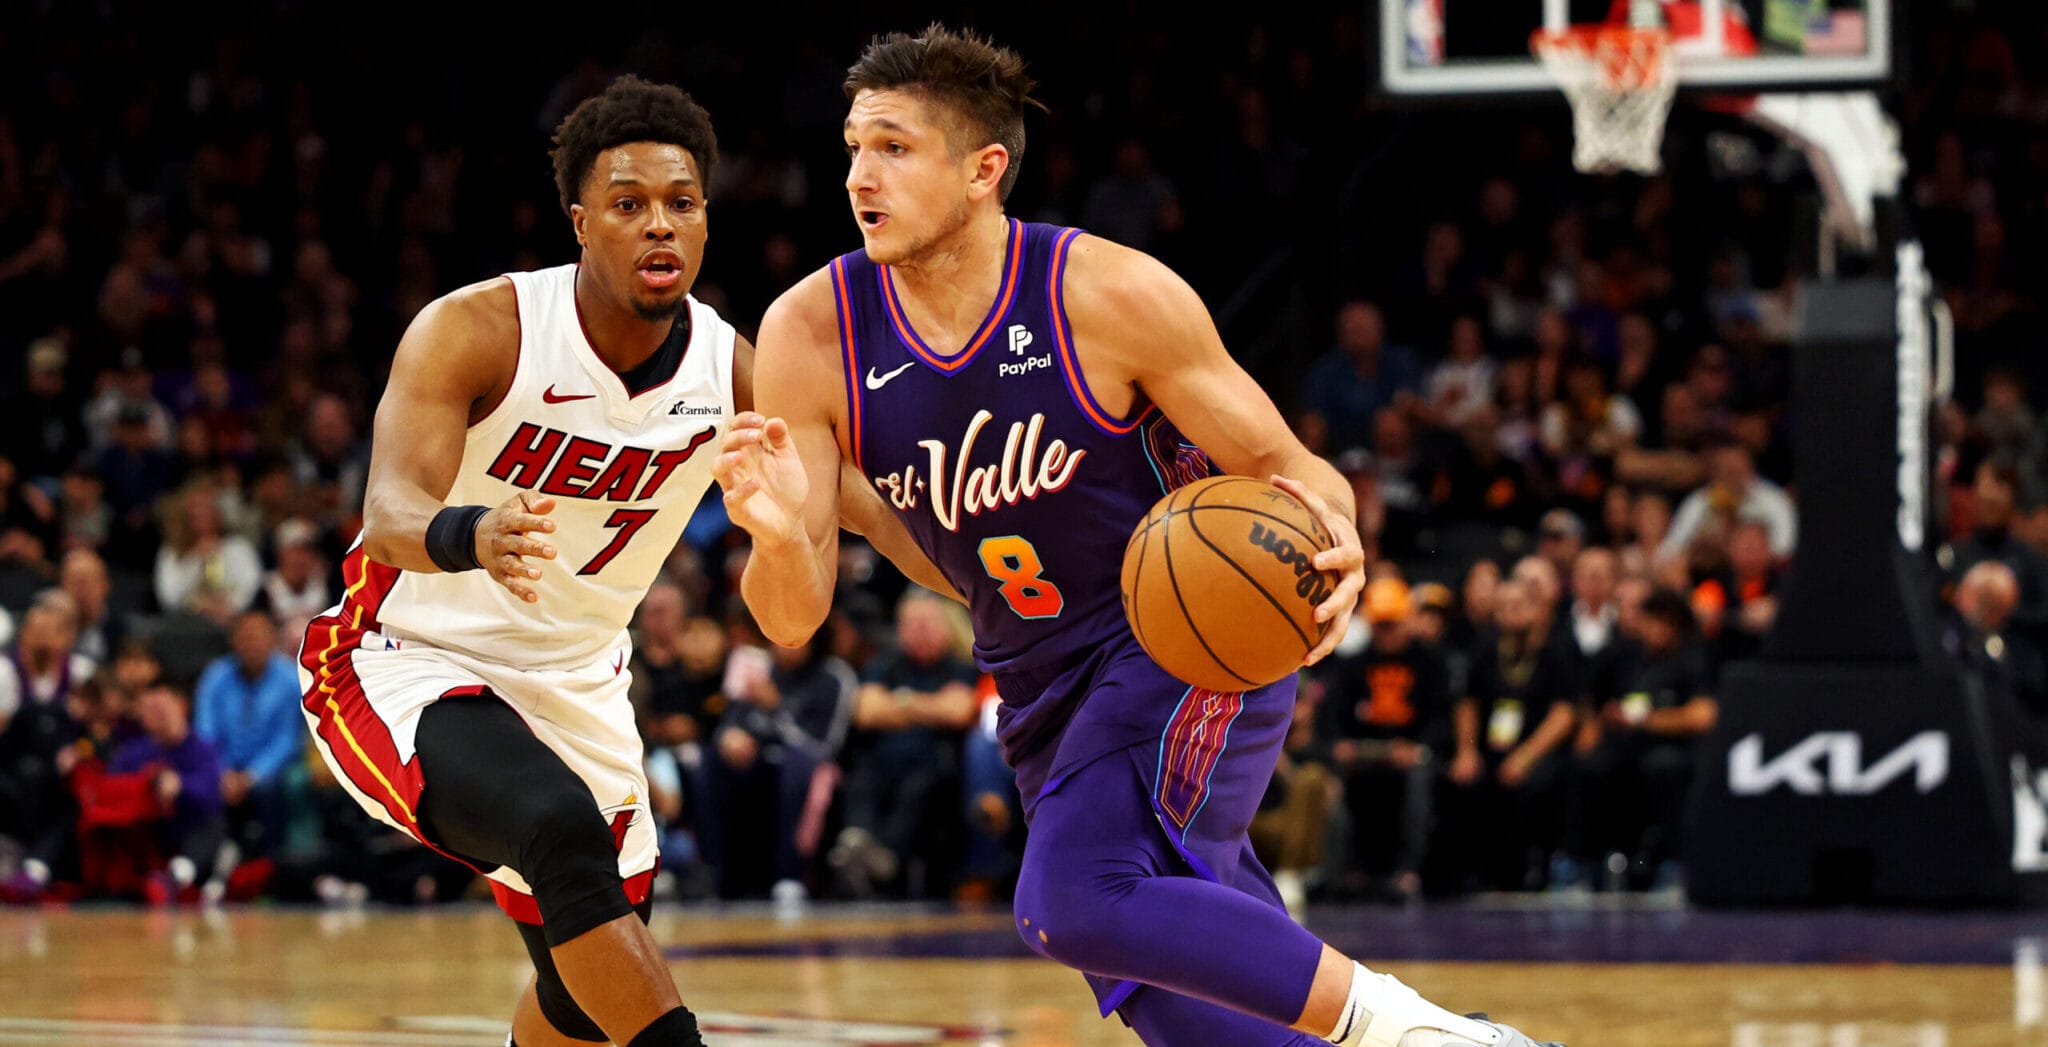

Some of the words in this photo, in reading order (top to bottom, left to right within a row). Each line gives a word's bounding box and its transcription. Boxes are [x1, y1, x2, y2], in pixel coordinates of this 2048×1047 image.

[999, 352, 1051, 378] PayPal
[679, 404, 722, 416] Carnival
[486, 421, 717, 502] HEAT
[917, 409, 1087, 532] Valle
[576, 508, 659, 575] 7
[977, 535, 1064, 620] 8
[1728, 731, 1949, 795] KIA
